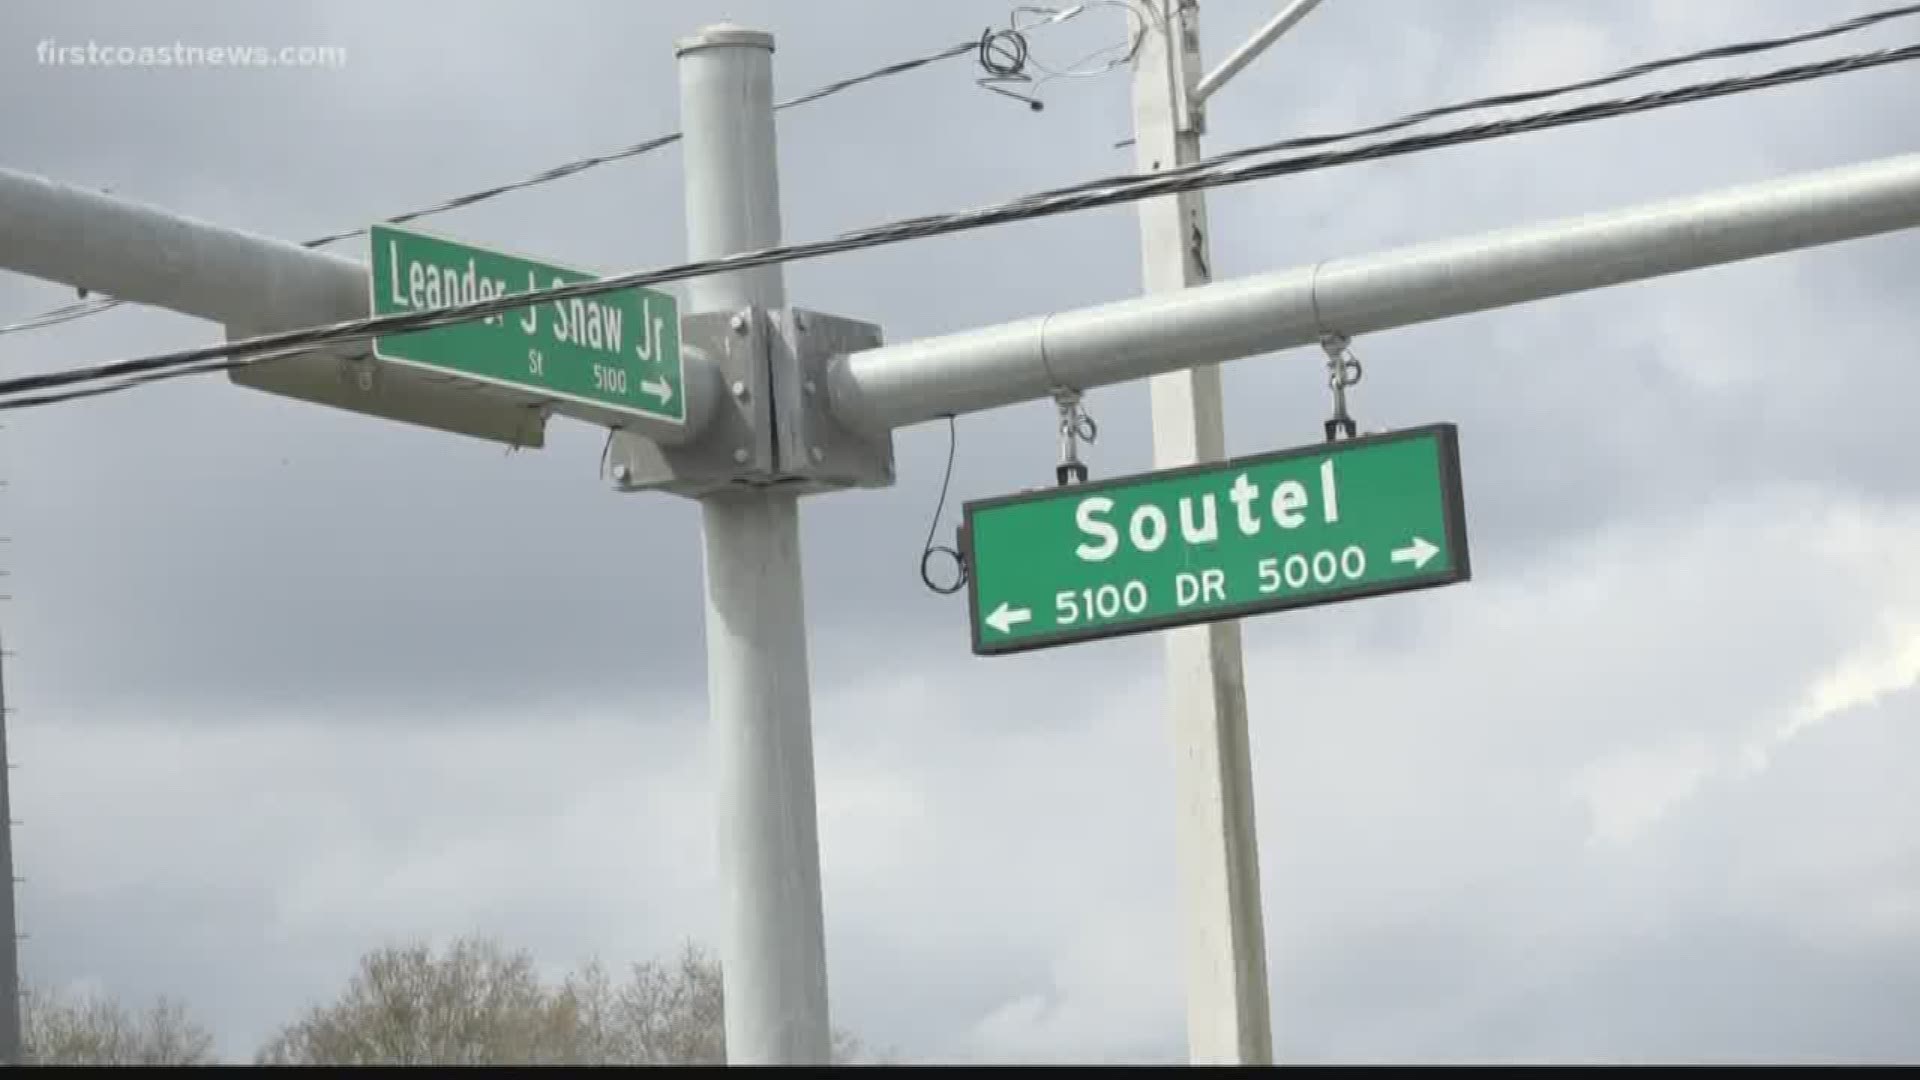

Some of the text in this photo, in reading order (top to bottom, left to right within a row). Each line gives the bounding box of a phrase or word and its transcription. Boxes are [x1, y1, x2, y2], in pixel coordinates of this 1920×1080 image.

[389, 239, 507, 327] Leander
[519, 270, 537, 335] J
[635, 297, 664, 364] Jr
[528, 349, 627, 394] St 5100
[1074, 458, 1340, 562] Soutel
[1055, 545, 1366, 624] 5100 DR 5000
